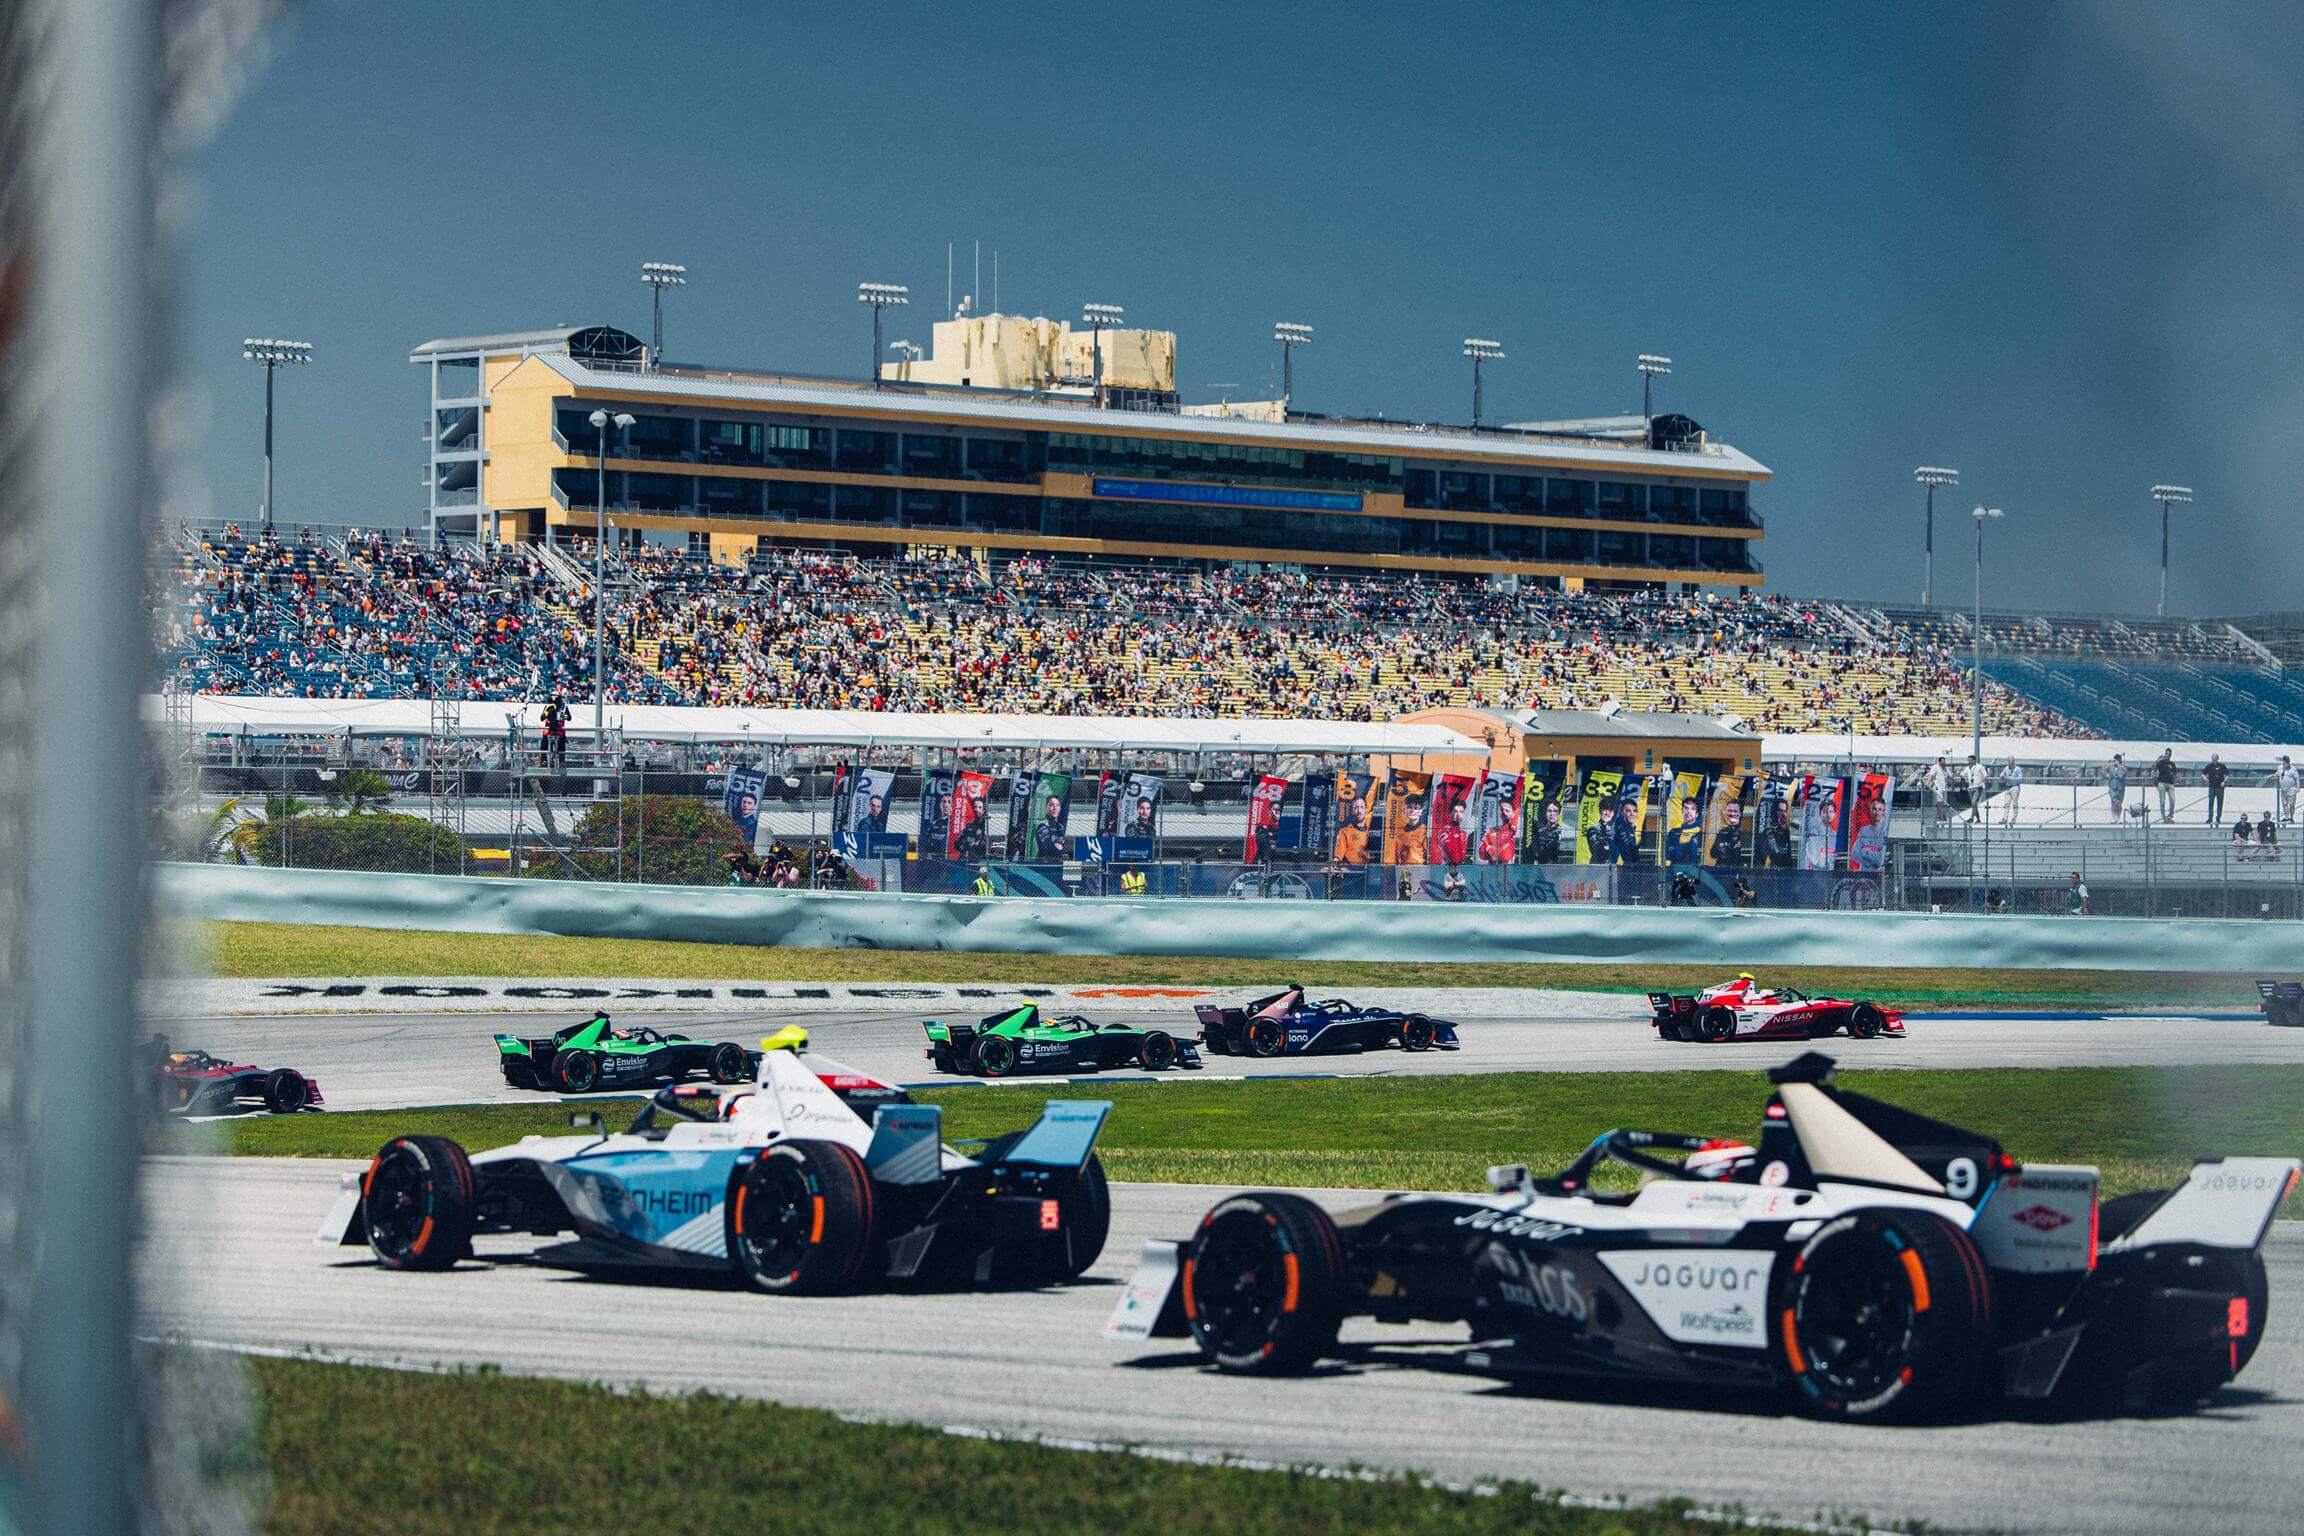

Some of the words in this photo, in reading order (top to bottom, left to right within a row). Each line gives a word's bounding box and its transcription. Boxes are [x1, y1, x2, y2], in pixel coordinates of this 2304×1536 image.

[730, 775, 761, 792] 55
[856, 776, 873, 794] 2
[958, 780, 983, 799] 13
[1126, 780, 1142, 798] 9
[1436, 782, 1465, 799] 17
[1483, 778, 1517, 800] 23
[1528, 780, 1544, 801] 3
[1585, 779, 1617, 798] 33
[1762, 779, 1788, 798] 25
[1807, 783, 1837, 802] 27
[1857, 780, 1884, 799] 51
[1773, 1011, 1814, 1024] NISSAN
[1035, 1043, 1069, 1053] Envision
[616, 1056, 647, 1067] Envision
[1945, 1157, 1978, 1200] 9
